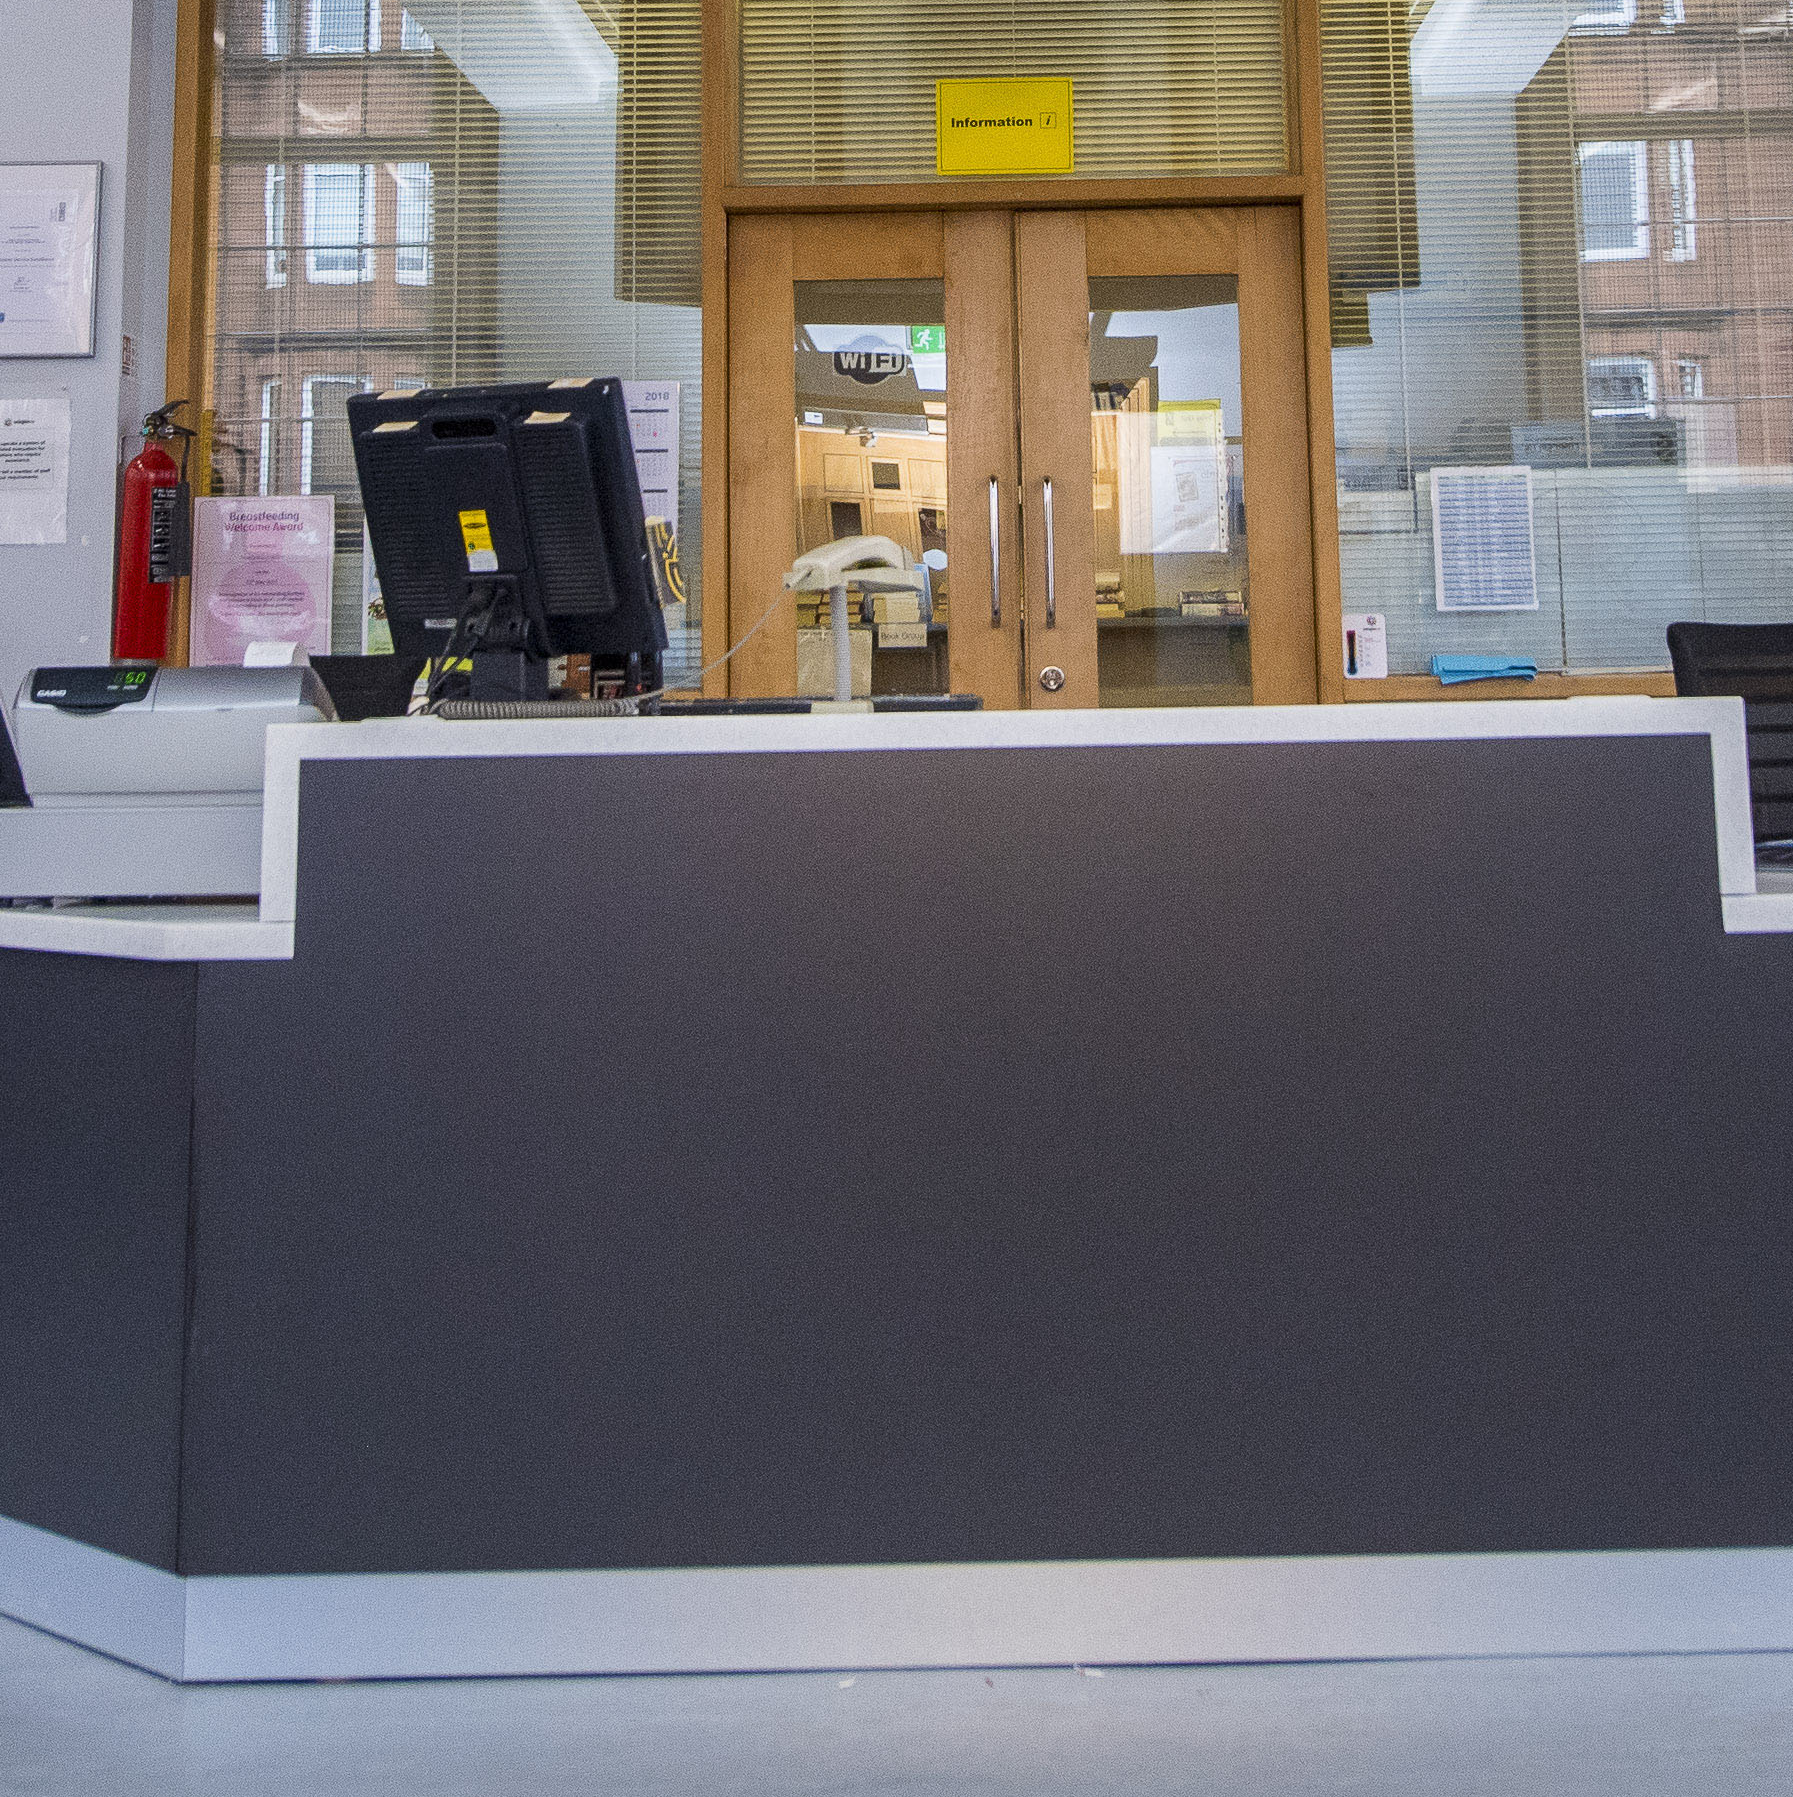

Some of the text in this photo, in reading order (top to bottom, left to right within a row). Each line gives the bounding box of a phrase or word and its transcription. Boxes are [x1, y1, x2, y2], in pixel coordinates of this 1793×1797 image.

[951, 116, 1033, 128] Information
[645, 392, 670, 401] 2018
[229, 510, 299, 523] Breastfeeding
[272, 521, 304, 532] Award
[881, 632, 899, 640] Book
